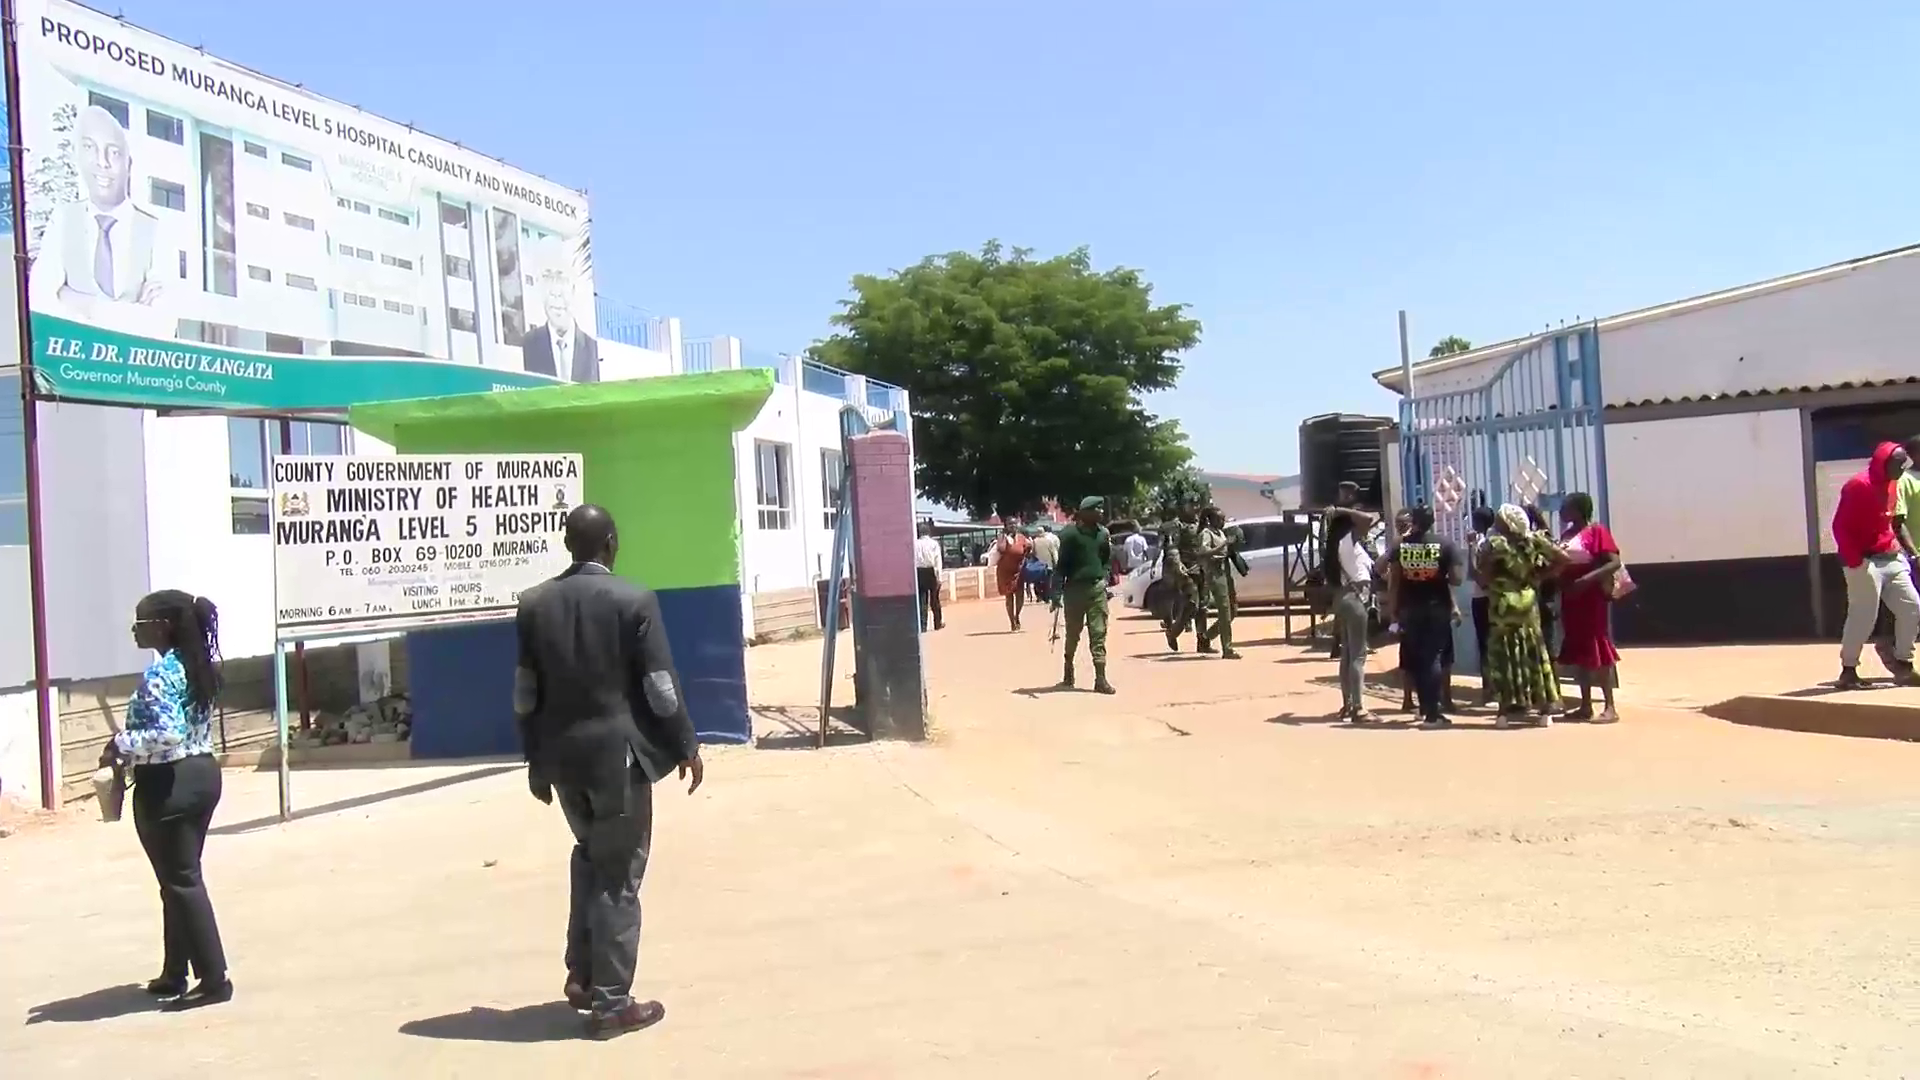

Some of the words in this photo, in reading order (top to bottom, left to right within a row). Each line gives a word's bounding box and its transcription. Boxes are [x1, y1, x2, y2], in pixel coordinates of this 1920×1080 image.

[41, 16, 165, 76] PROPOSED
[172, 63, 268, 114] MURANGA
[273, 99, 320, 131] LEVEL
[324, 118, 332, 135] 5
[337, 121, 405, 160] HOSPITAL
[408, 147, 472, 182] CASUALTY
[474, 171, 500, 192] AND
[502, 179, 542, 207] WARDS
[544, 192, 577, 220] BLOCK
[46, 337, 85, 360] H.E.
[89, 342, 123, 363] DR.
[128, 346, 197, 371] IRUNGU
[199, 356, 274, 380] KANGATA
[60, 363, 123, 384] Governor
[127, 371, 183, 392] Murang'a
[186, 376, 227, 396] County
[275, 462, 334, 482] COUNTY
[347, 461, 452, 481] GOVERNMENT
[465, 461, 483, 480] OF
[497, 456, 578, 479] MURANG'A
[326, 487, 422, 513] MINISTRY
[436, 486, 458, 509] OF
[471, 484, 538, 509] HEALTH
[276, 514, 381, 545] MURANG'A
[398, 516, 449, 540] LEVEL
[466, 515, 478, 537] 5
[496, 511, 568, 536] HOSPITA
[326, 549, 359, 566] P.O.
[371, 547, 402, 564] BOX
[402, 586, 439, 597] VISITING
[450, 583, 482, 594] HOURS
[279, 607, 323, 619] MORNING
[412, 597, 441, 609] LUNCH
